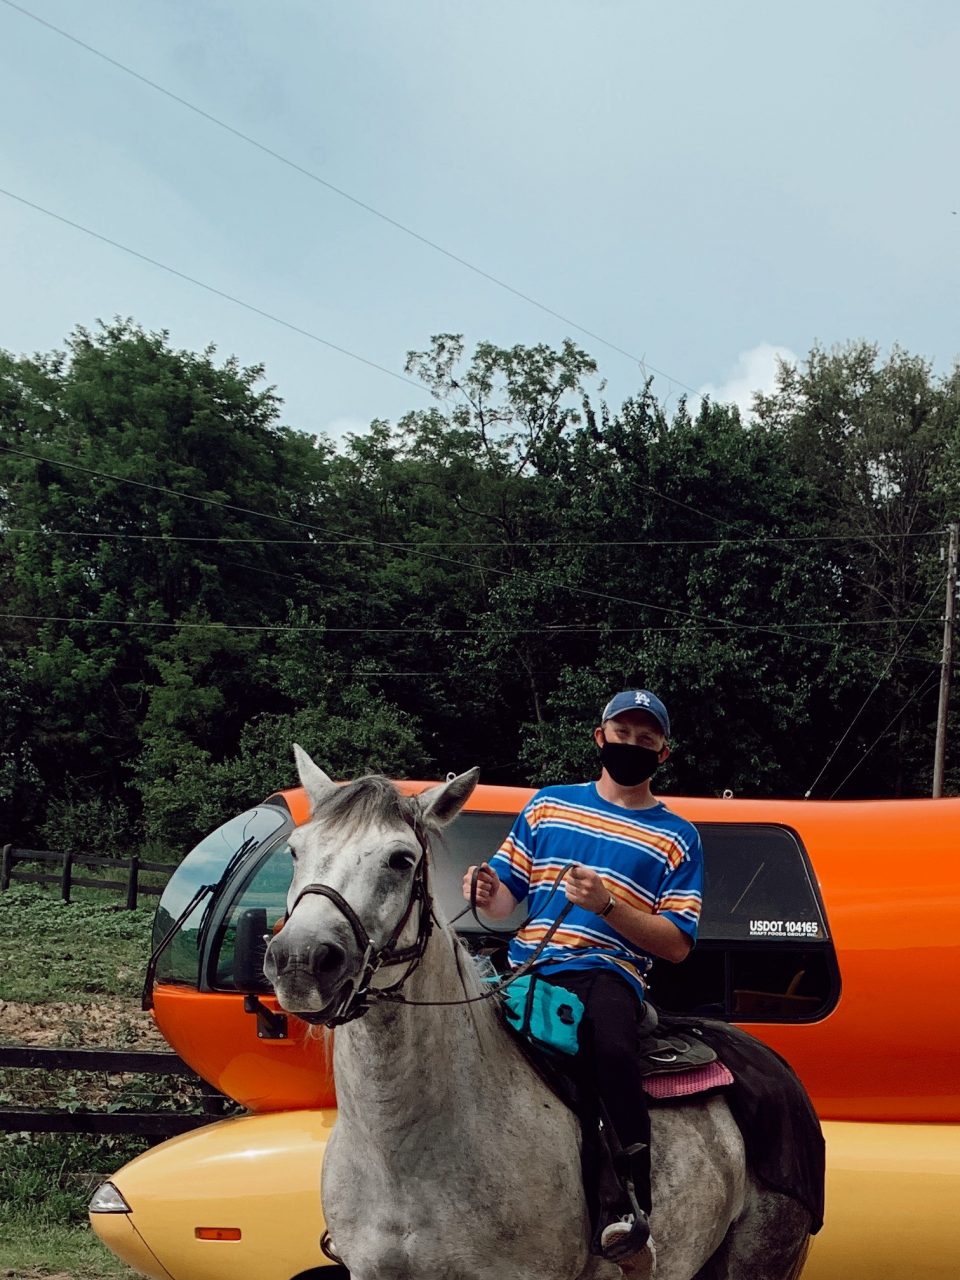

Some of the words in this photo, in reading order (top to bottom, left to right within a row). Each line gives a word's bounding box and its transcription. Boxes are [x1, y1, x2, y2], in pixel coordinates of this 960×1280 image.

[635, 691, 651, 707] LA
[750, 920, 783, 931] USDOT
[785, 921, 818, 932] 104165
